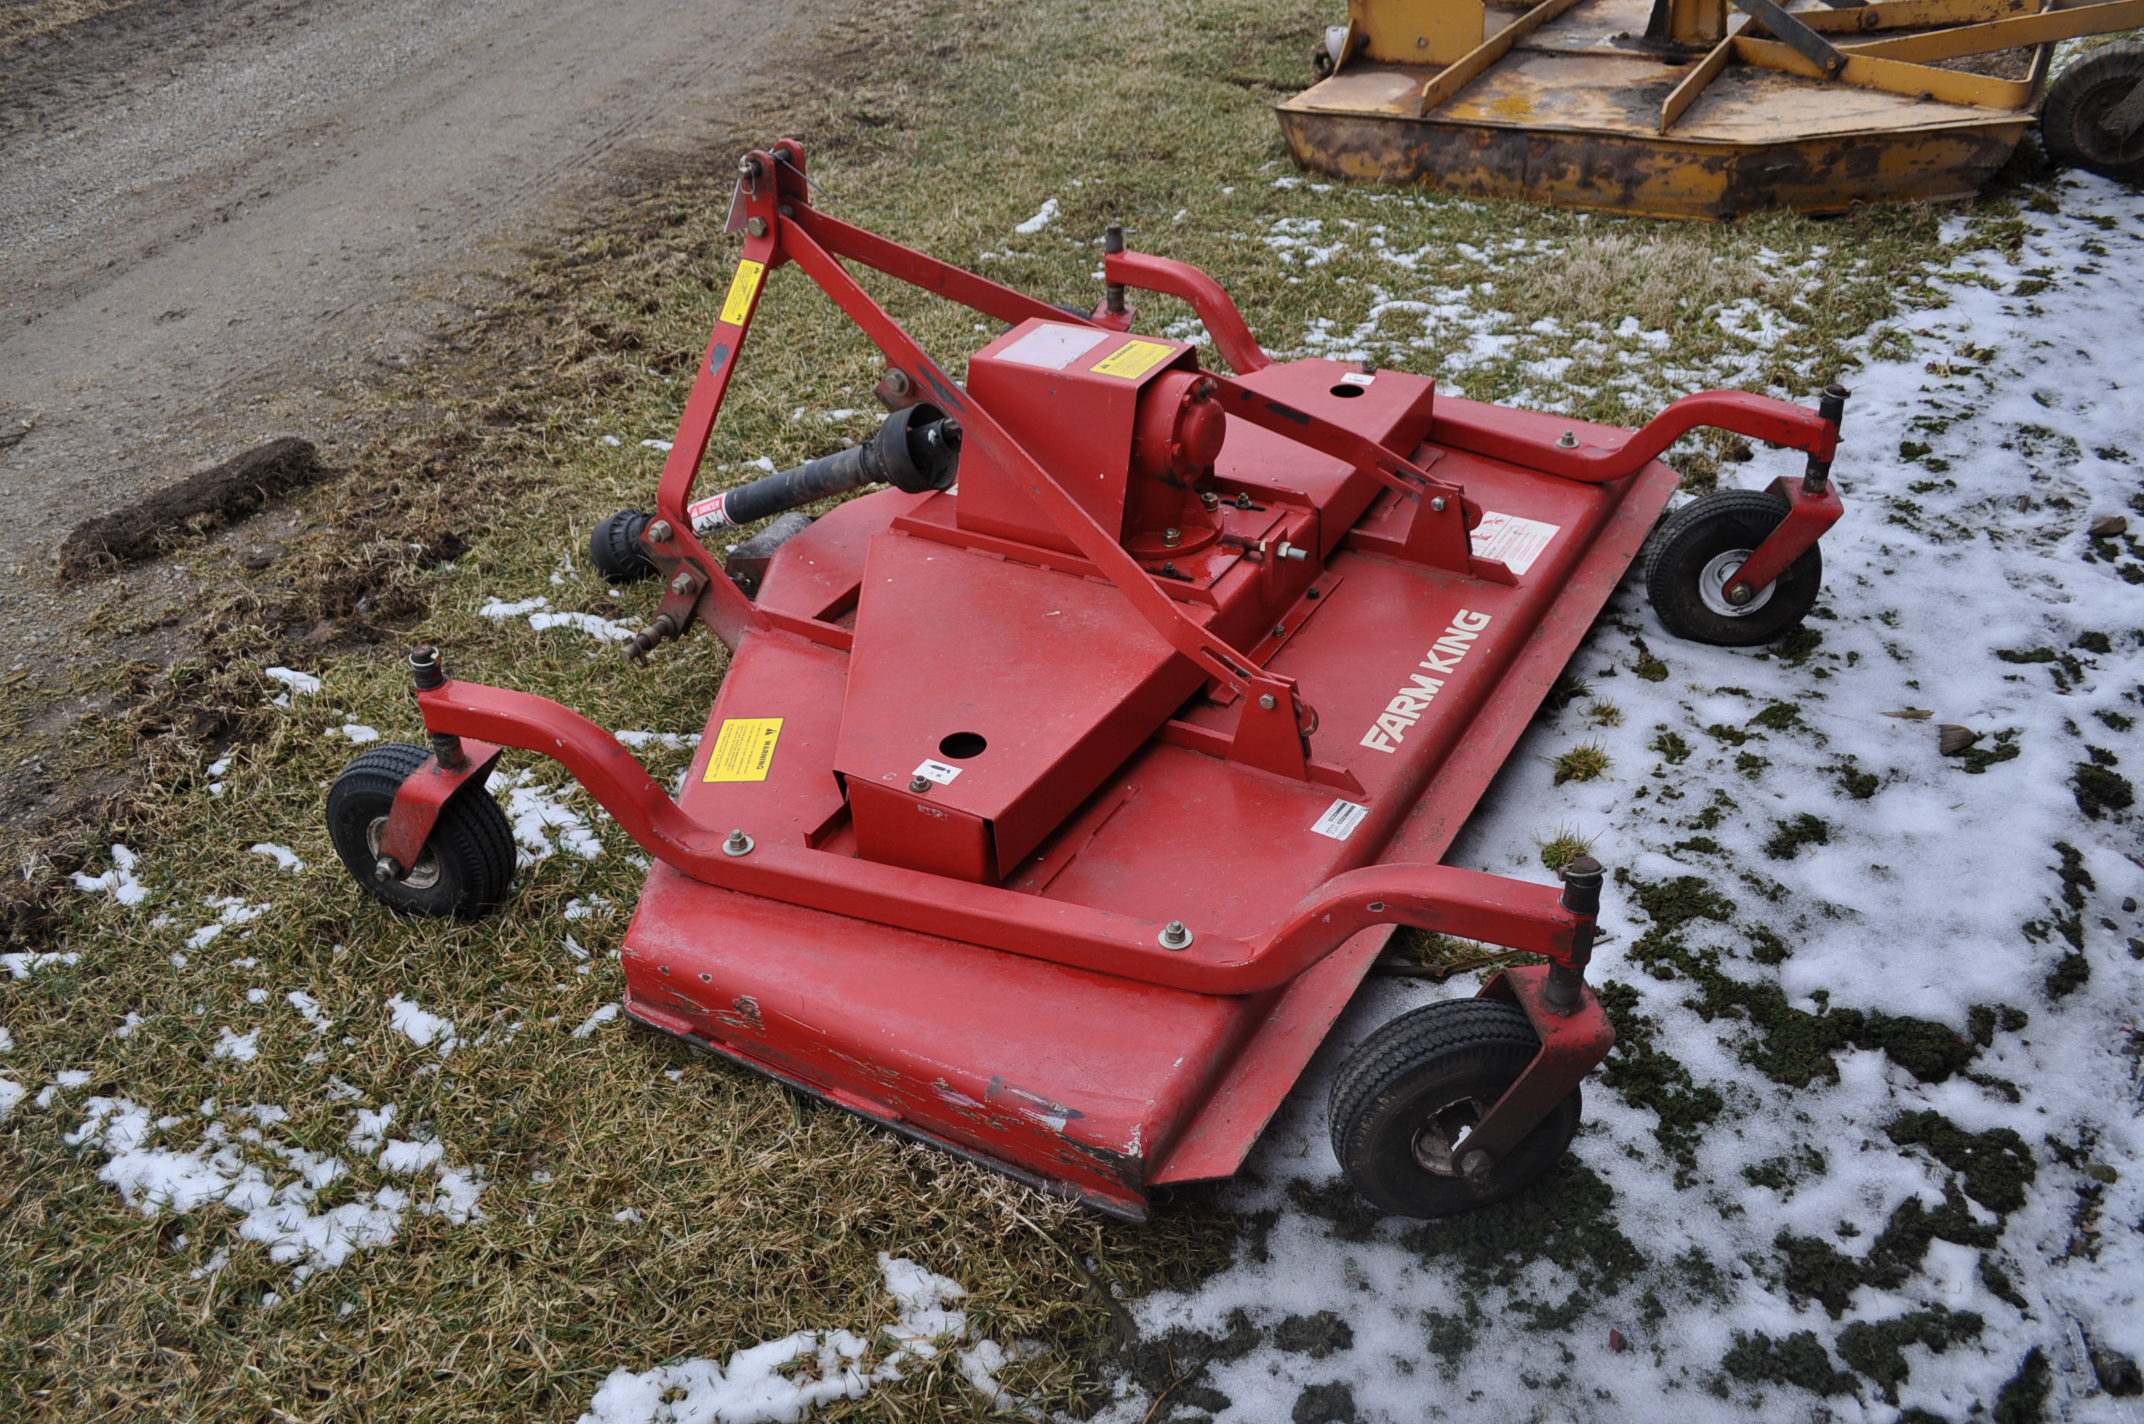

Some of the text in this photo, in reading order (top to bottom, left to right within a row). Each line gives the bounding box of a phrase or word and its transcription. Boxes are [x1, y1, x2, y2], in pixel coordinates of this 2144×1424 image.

[1359, 608, 1493, 754] FARM KING
[756, 740, 771, 770] WARNING
